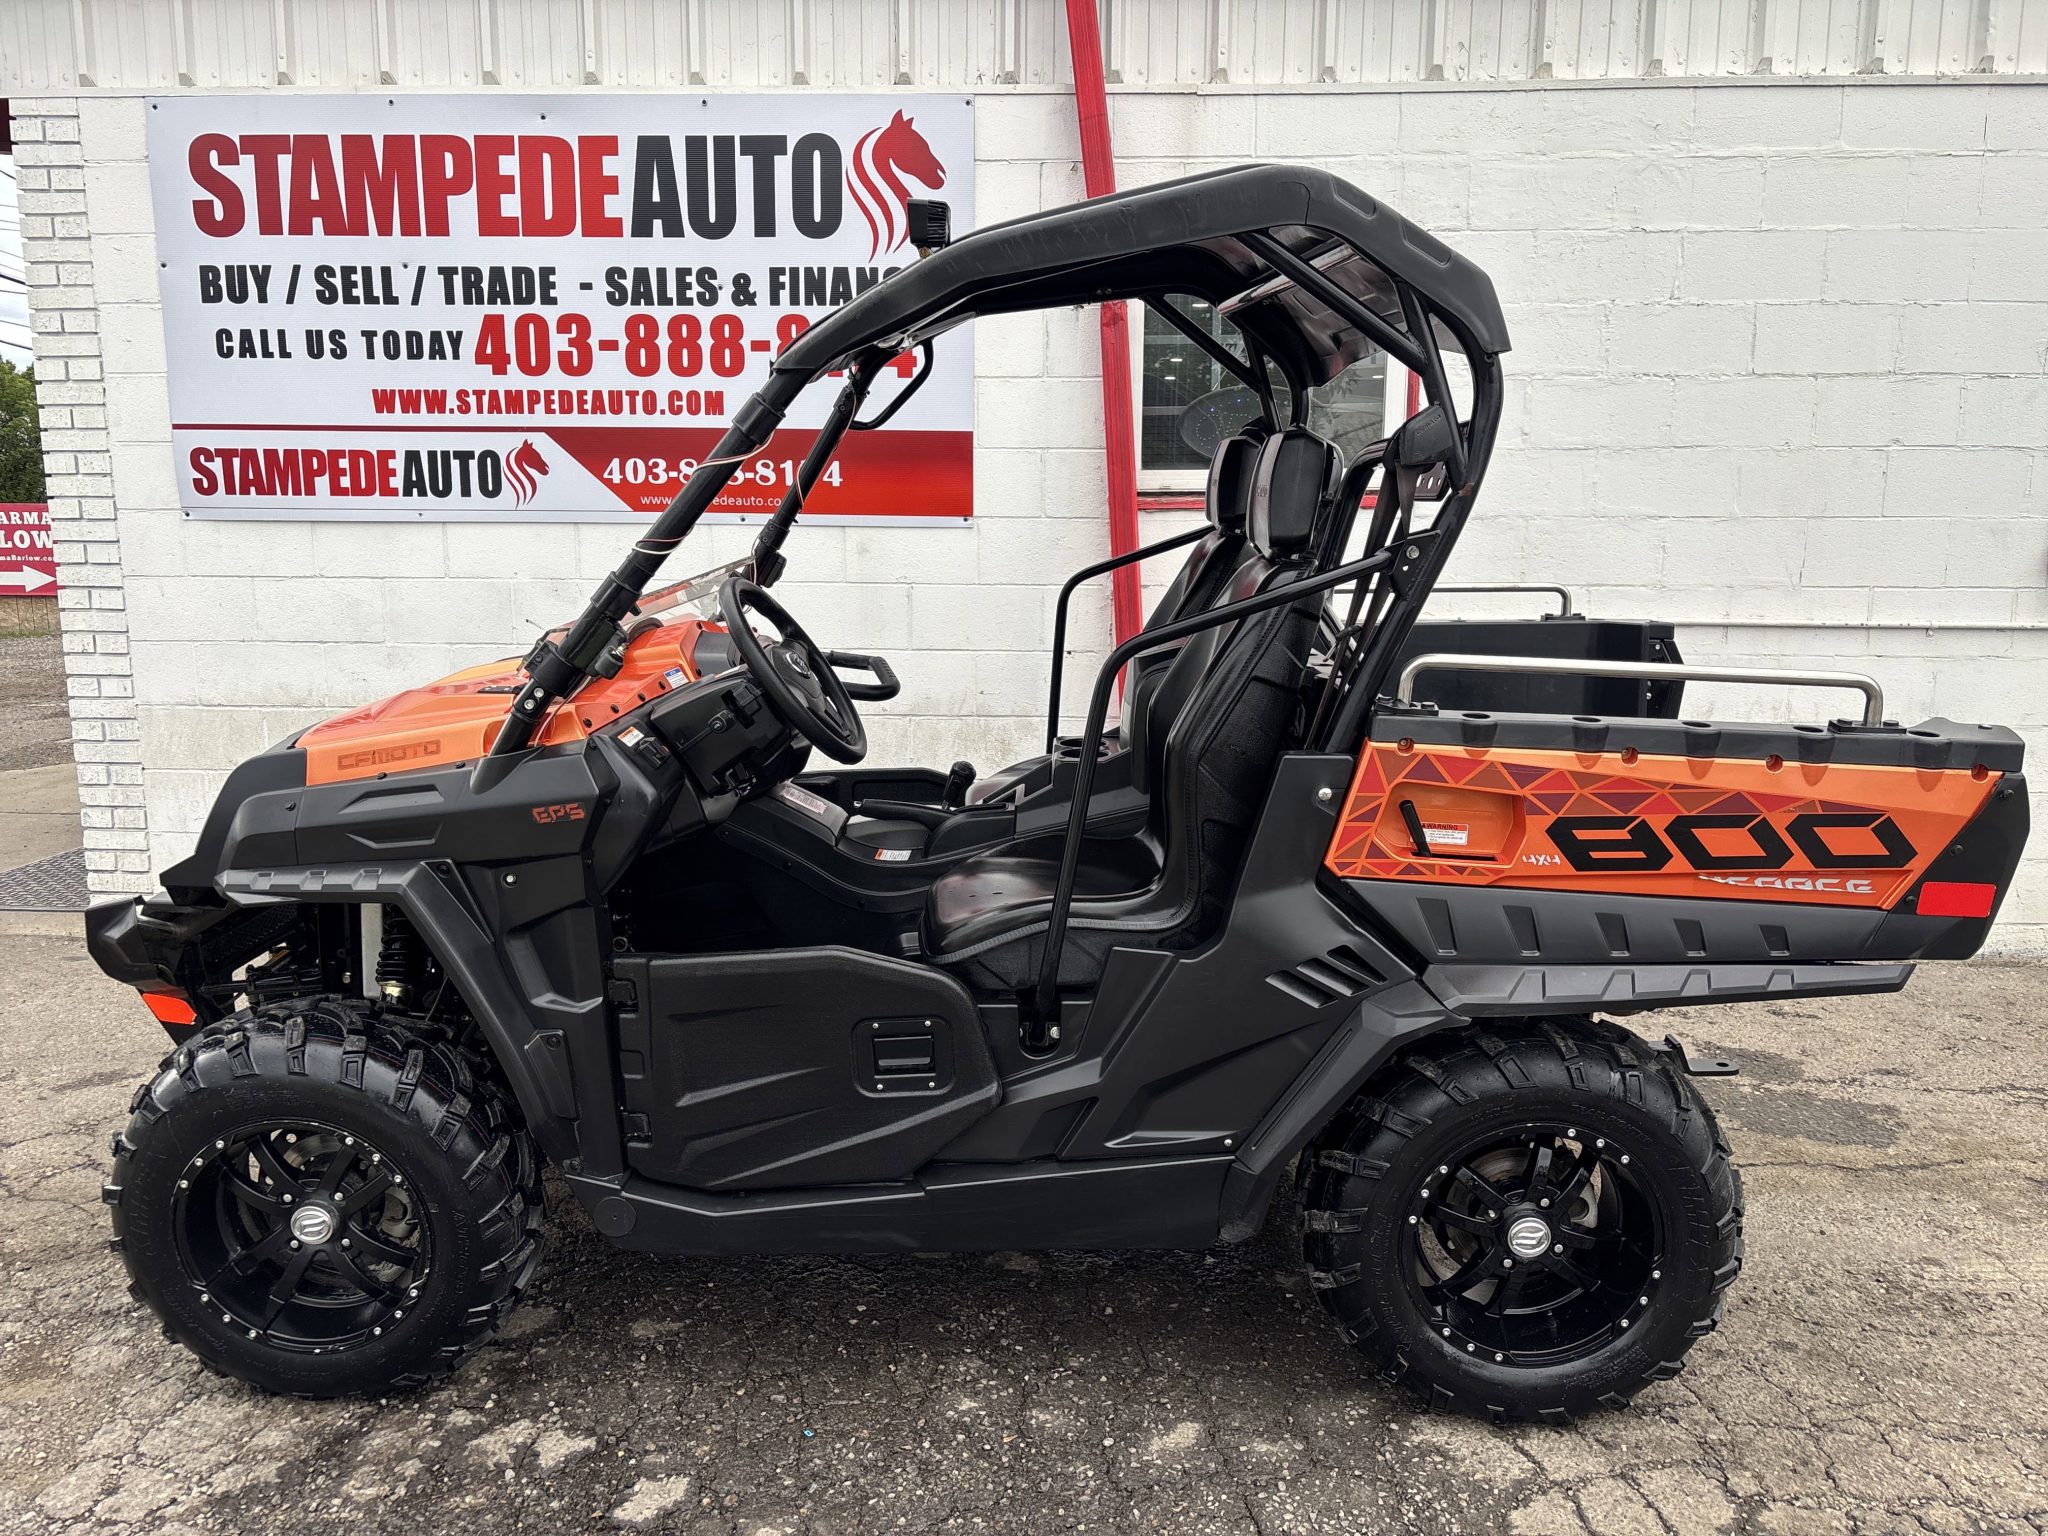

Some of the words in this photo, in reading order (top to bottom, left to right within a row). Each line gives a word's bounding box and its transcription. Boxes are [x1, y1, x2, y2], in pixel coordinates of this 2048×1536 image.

[199, 264, 271, 304] BUY
[314, 265, 399, 306] SELL
[437, 266, 558, 305] TRADE
[605, 266, 718, 307] SALES
[731, 272, 757, 306] &
[769, 266, 902, 306] FINAN
[215, 328, 292, 359] CALL
[305, 329, 348, 360] US
[361, 330, 463, 360] TODAY
[371, 388, 724, 416] WWW.STAMPEDEAUTO.COM
[532, 802, 585, 824] EPS
[1426, 823, 1459, 831] WARNING
